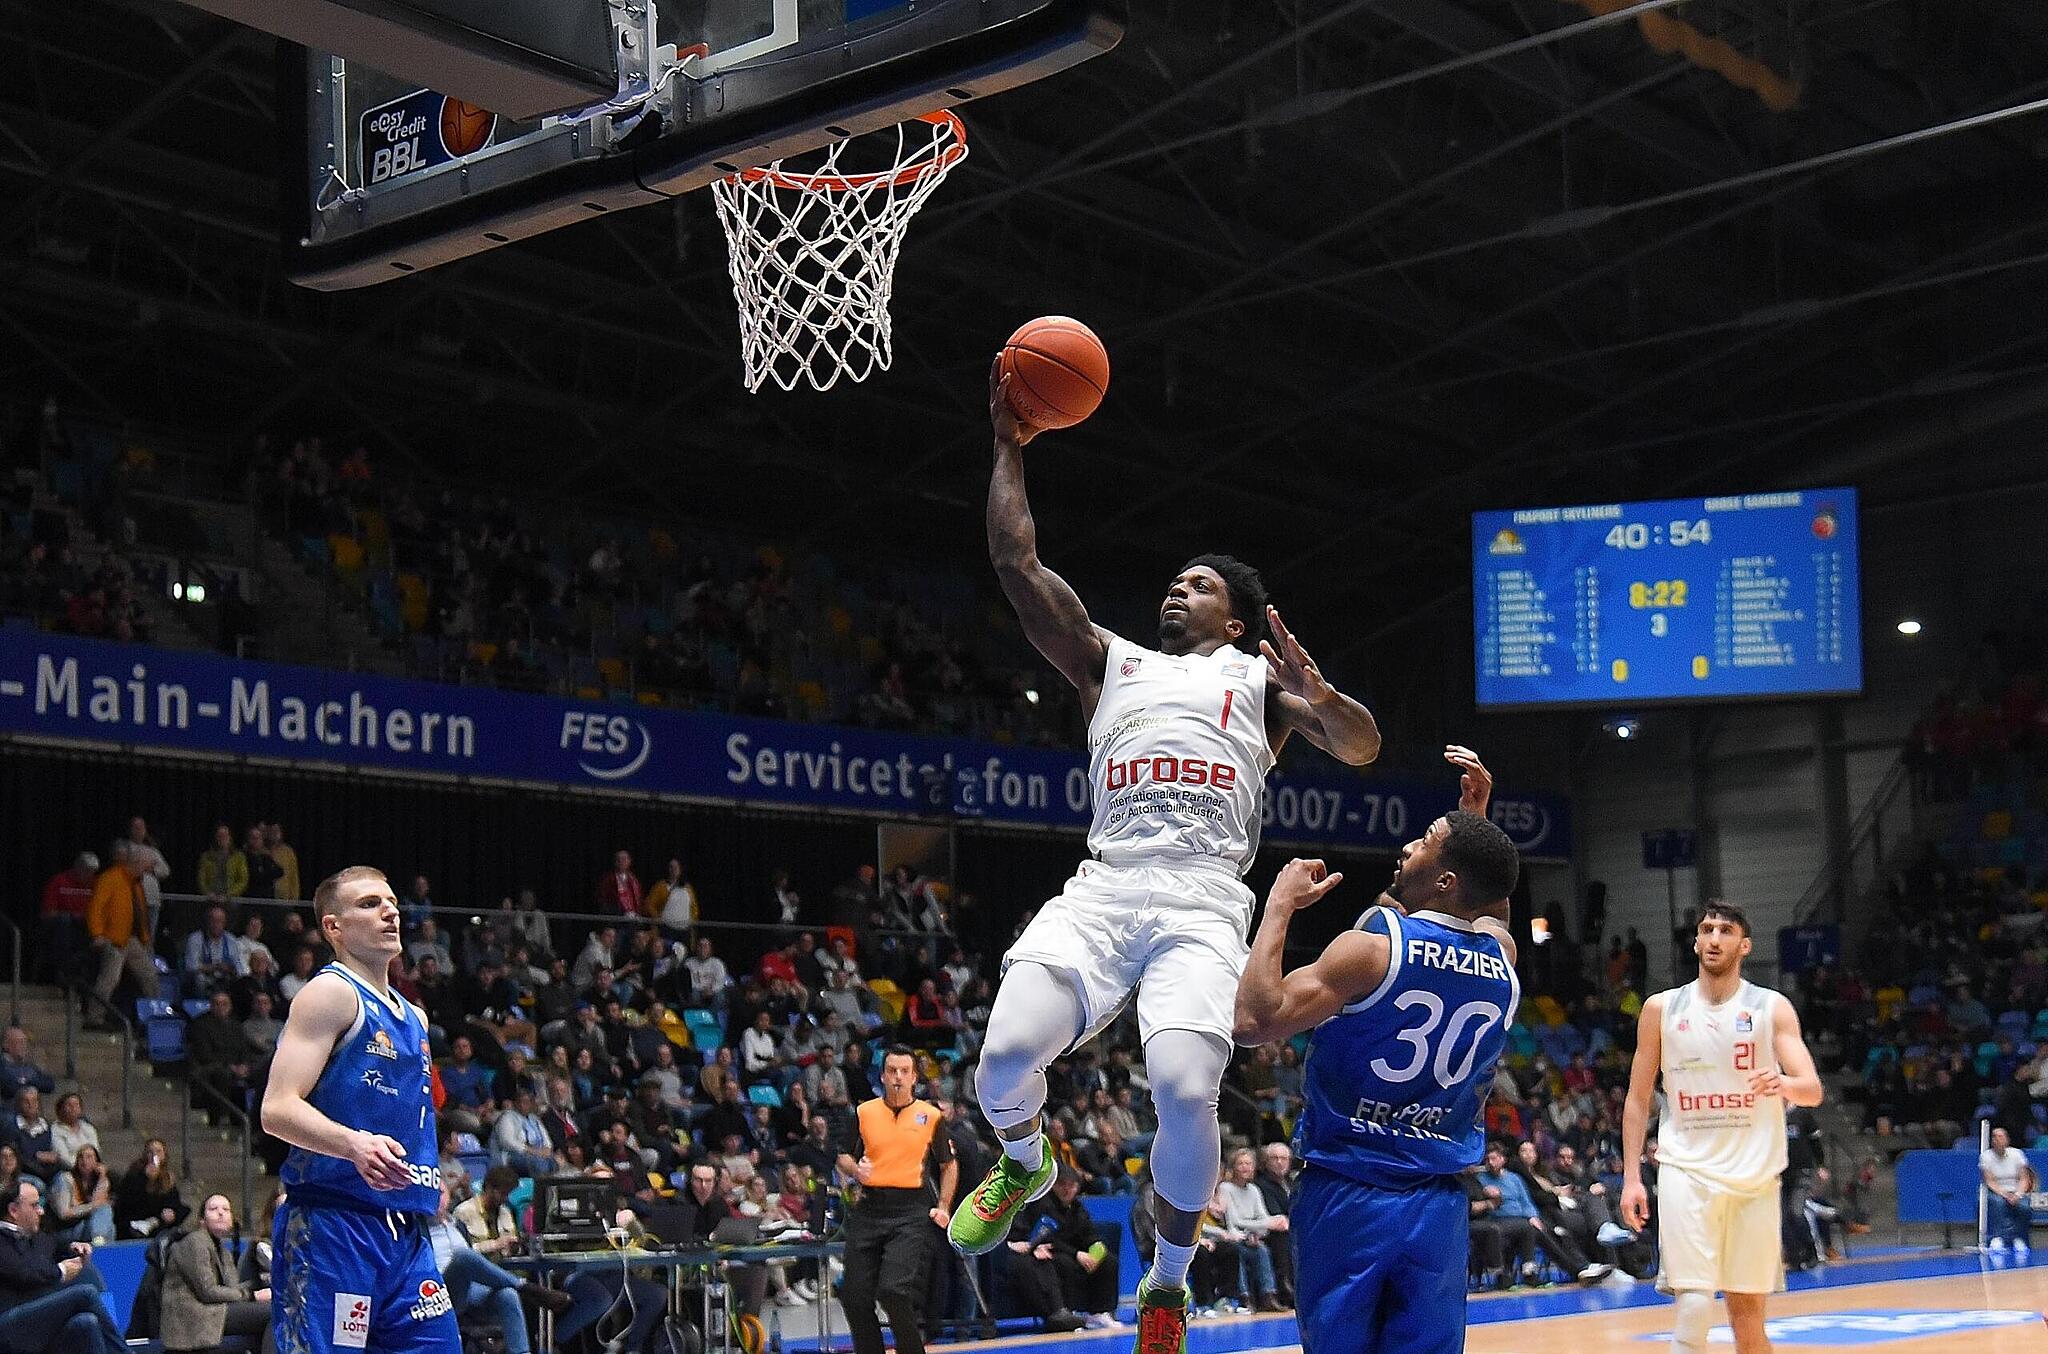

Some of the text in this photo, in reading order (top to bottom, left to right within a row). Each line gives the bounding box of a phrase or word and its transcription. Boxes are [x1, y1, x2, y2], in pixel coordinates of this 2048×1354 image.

[387, 115, 427, 142] Credit
[371, 137, 427, 183] BBL
[1605, 523, 1650, 550] 40
[1669, 518, 1712, 547] 54
[1629, 579, 1688, 609] 8:22
[1650, 612, 1669, 638] 3
[1220, 689, 1234, 731] 1
[560, 711, 630, 756] FES
[726, 732, 1048, 808] Servicetfon
[1106, 757, 1237, 792] brose
[1182, 790, 1225, 808] Partner
[1110, 810, 1126, 824] der
[1407, 939, 1509, 982] FRAZIER
[1369, 989, 1502, 1090] 30
[1733, 1041, 1756, 1071] 21
[1355, 1097, 1453, 1128] FRPOR
[1678, 1088, 1755, 1112] brose
